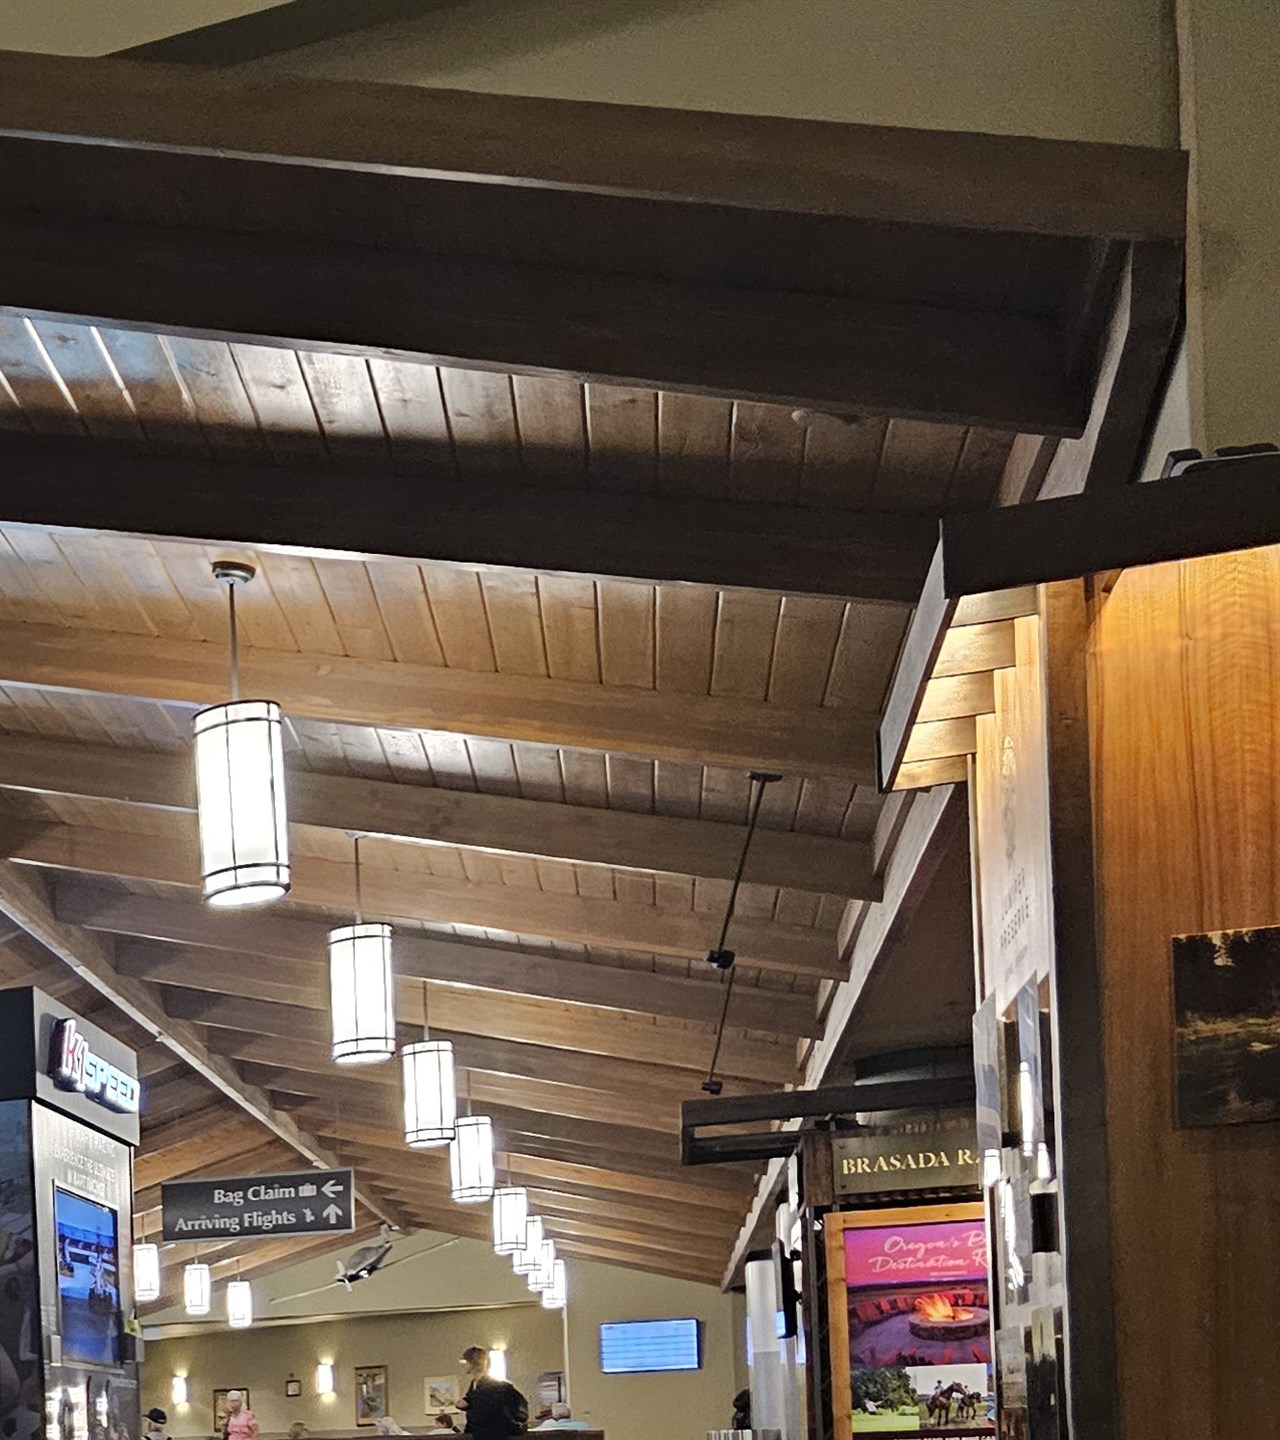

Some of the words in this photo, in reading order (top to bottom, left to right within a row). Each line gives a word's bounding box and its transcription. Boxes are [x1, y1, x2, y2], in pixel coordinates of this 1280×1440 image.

[842, 1151, 950, 1175] BRASADA
[957, 1149, 981, 1166] R
[213, 1189, 244, 1206] Bag
[247, 1184, 295, 1201] Claim
[175, 1213, 240, 1232] Arriving
[243, 1210, 297, 1229] Flights
[884, 1235, 962, 1259] Oregon's
[868, 1255, 971, 1273] Destination
